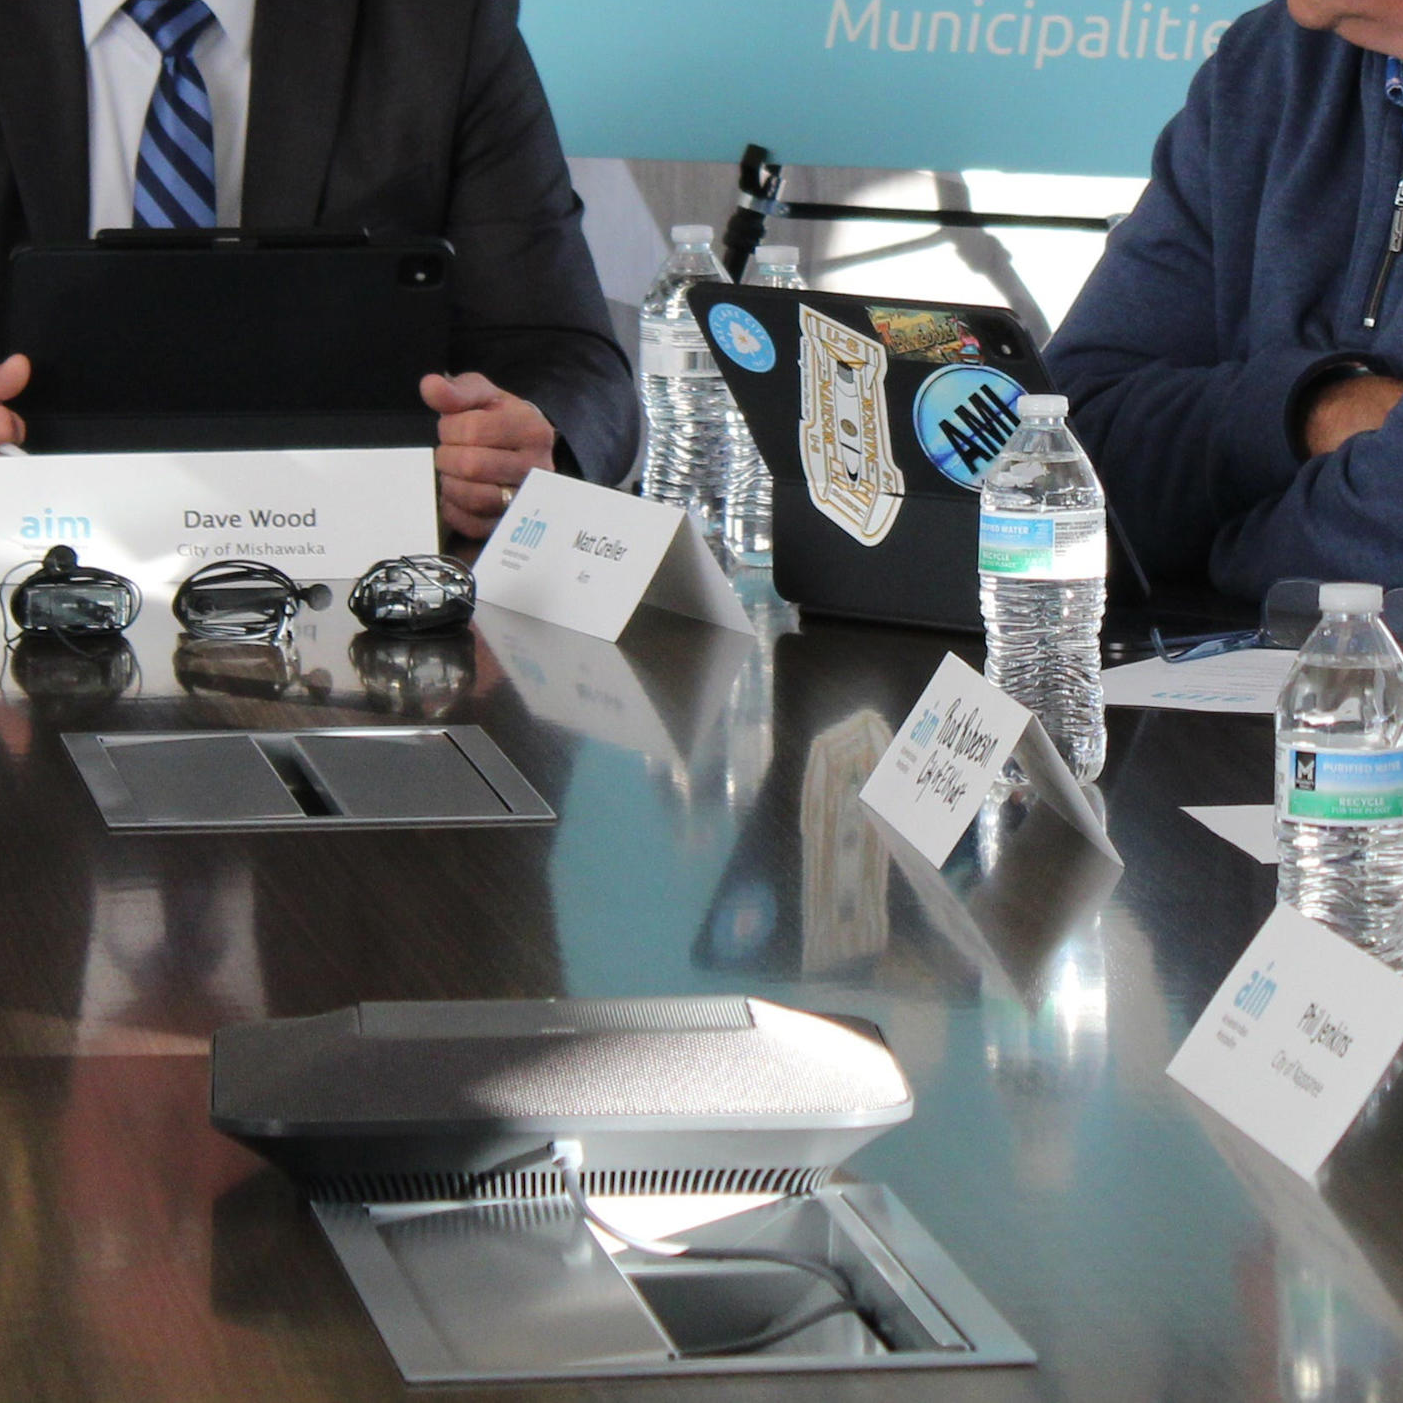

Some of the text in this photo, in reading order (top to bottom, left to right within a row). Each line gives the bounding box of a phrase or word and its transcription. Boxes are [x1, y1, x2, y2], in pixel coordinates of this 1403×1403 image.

[938, 384, 1022, 475] AMI
[20, 508, 91, 540] aim
[183, 509, 317, 529] Dave Wood
[509, 508, 547, 549] aim
[177, 542, 326, 559] City of Mishawaka
[572, 529, 597, 553] Matt
[909, 700, 940, 749] aim
[1323, 761, 1373, 774] PURIFIED
[1339, 797, 1385, 807] RECYCLE
[1234, 960, 1277, 1021] aim
